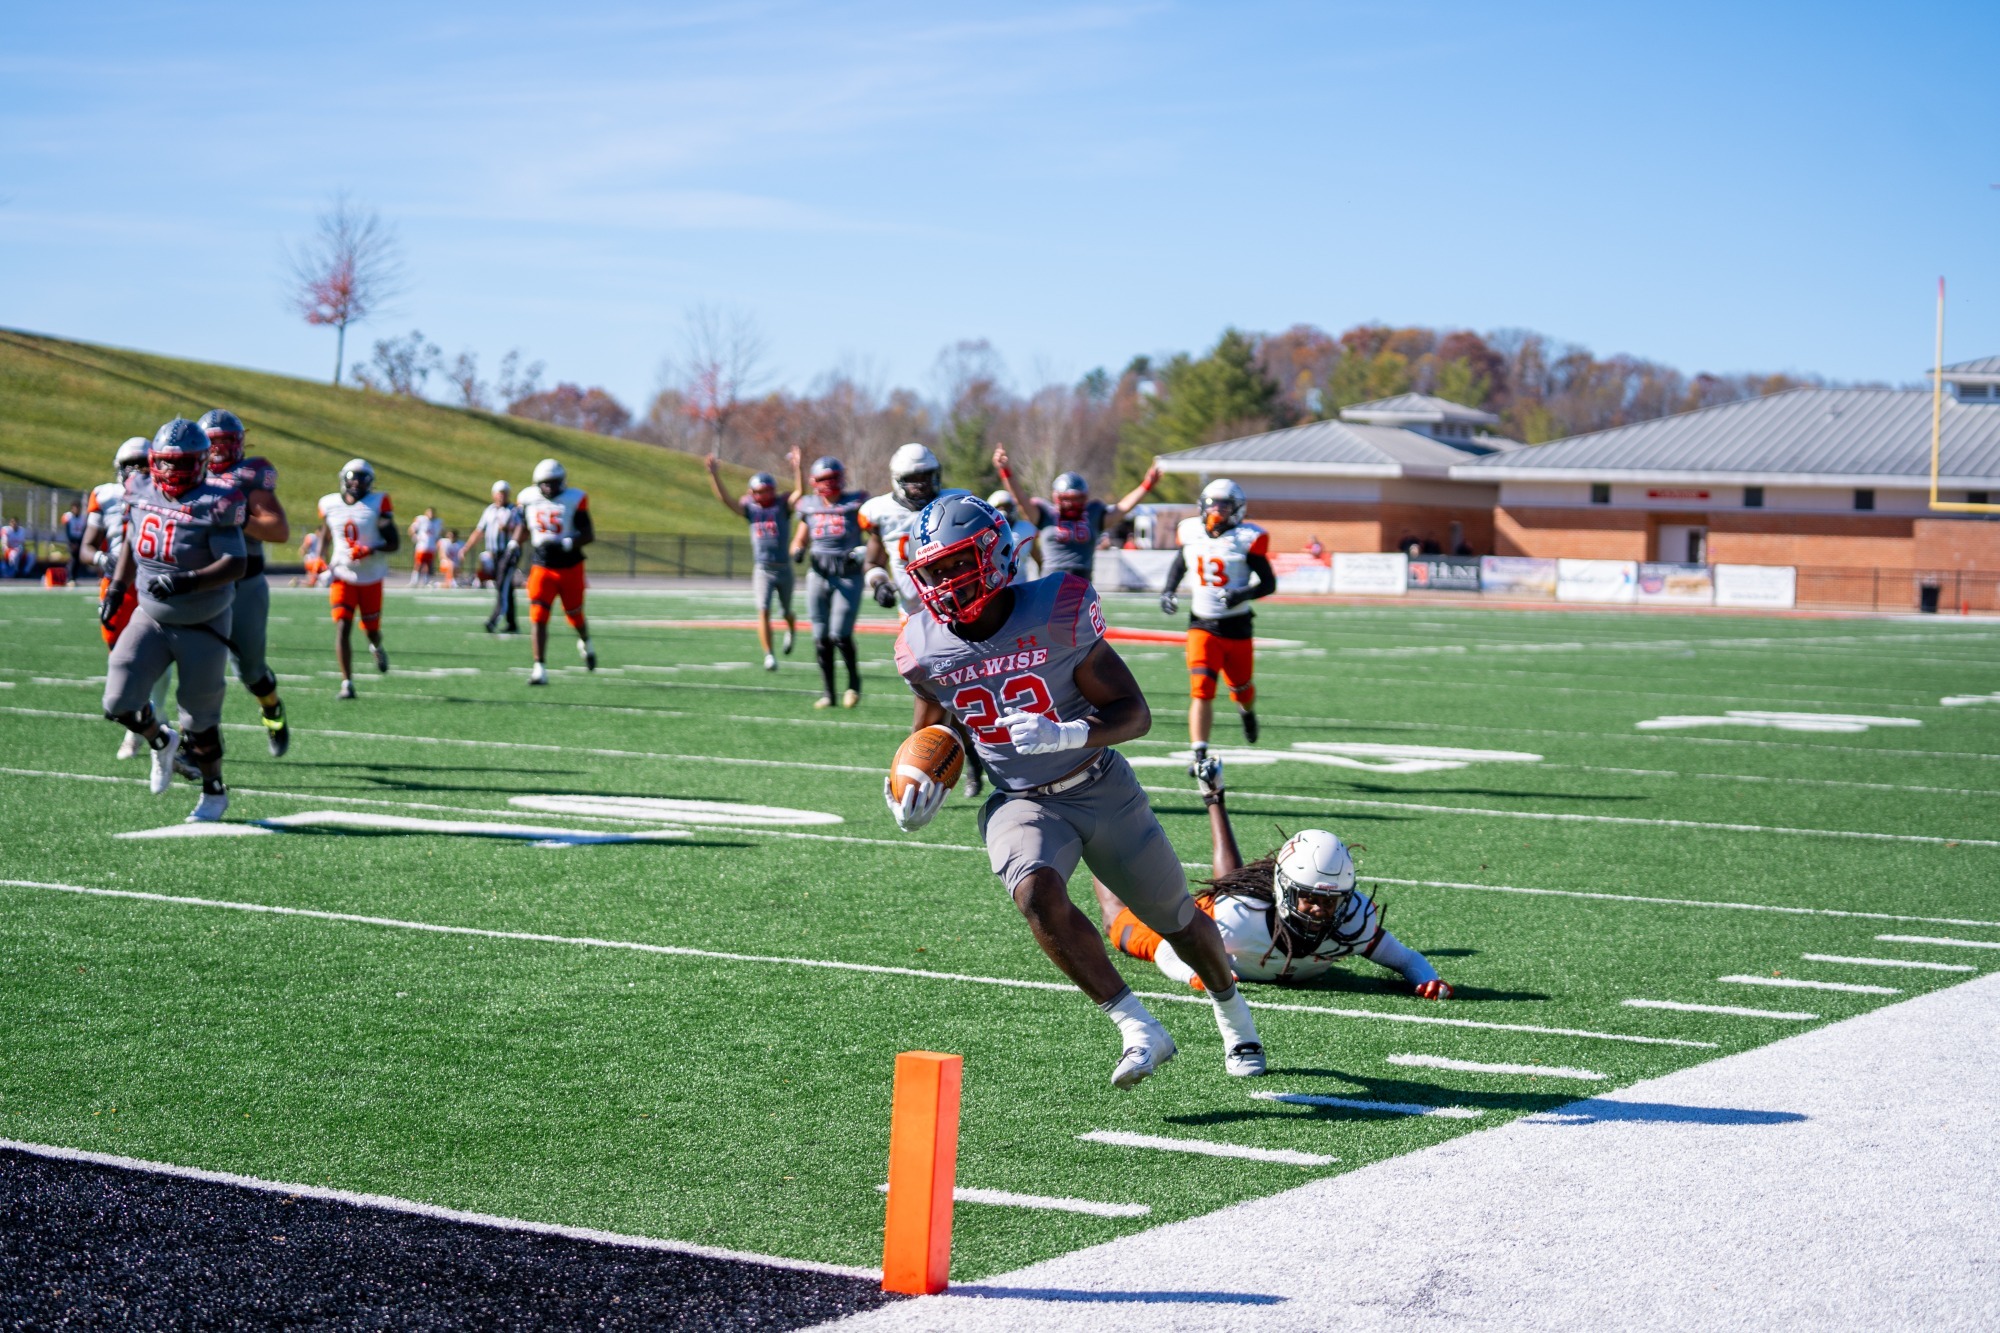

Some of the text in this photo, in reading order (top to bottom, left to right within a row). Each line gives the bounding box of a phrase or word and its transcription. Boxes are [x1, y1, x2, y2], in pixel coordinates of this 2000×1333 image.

[136, 511, 178, 564] 61
[536, 511, 563, 534] 55
[917, 543, 939, 556] Riddell
[1197, 556, 1229, 587] 13
[934, 660, 952, 672] SAC
[934, 648, 1048, 686] UVA-WISE
[953, 672, 1062, 744] 22
